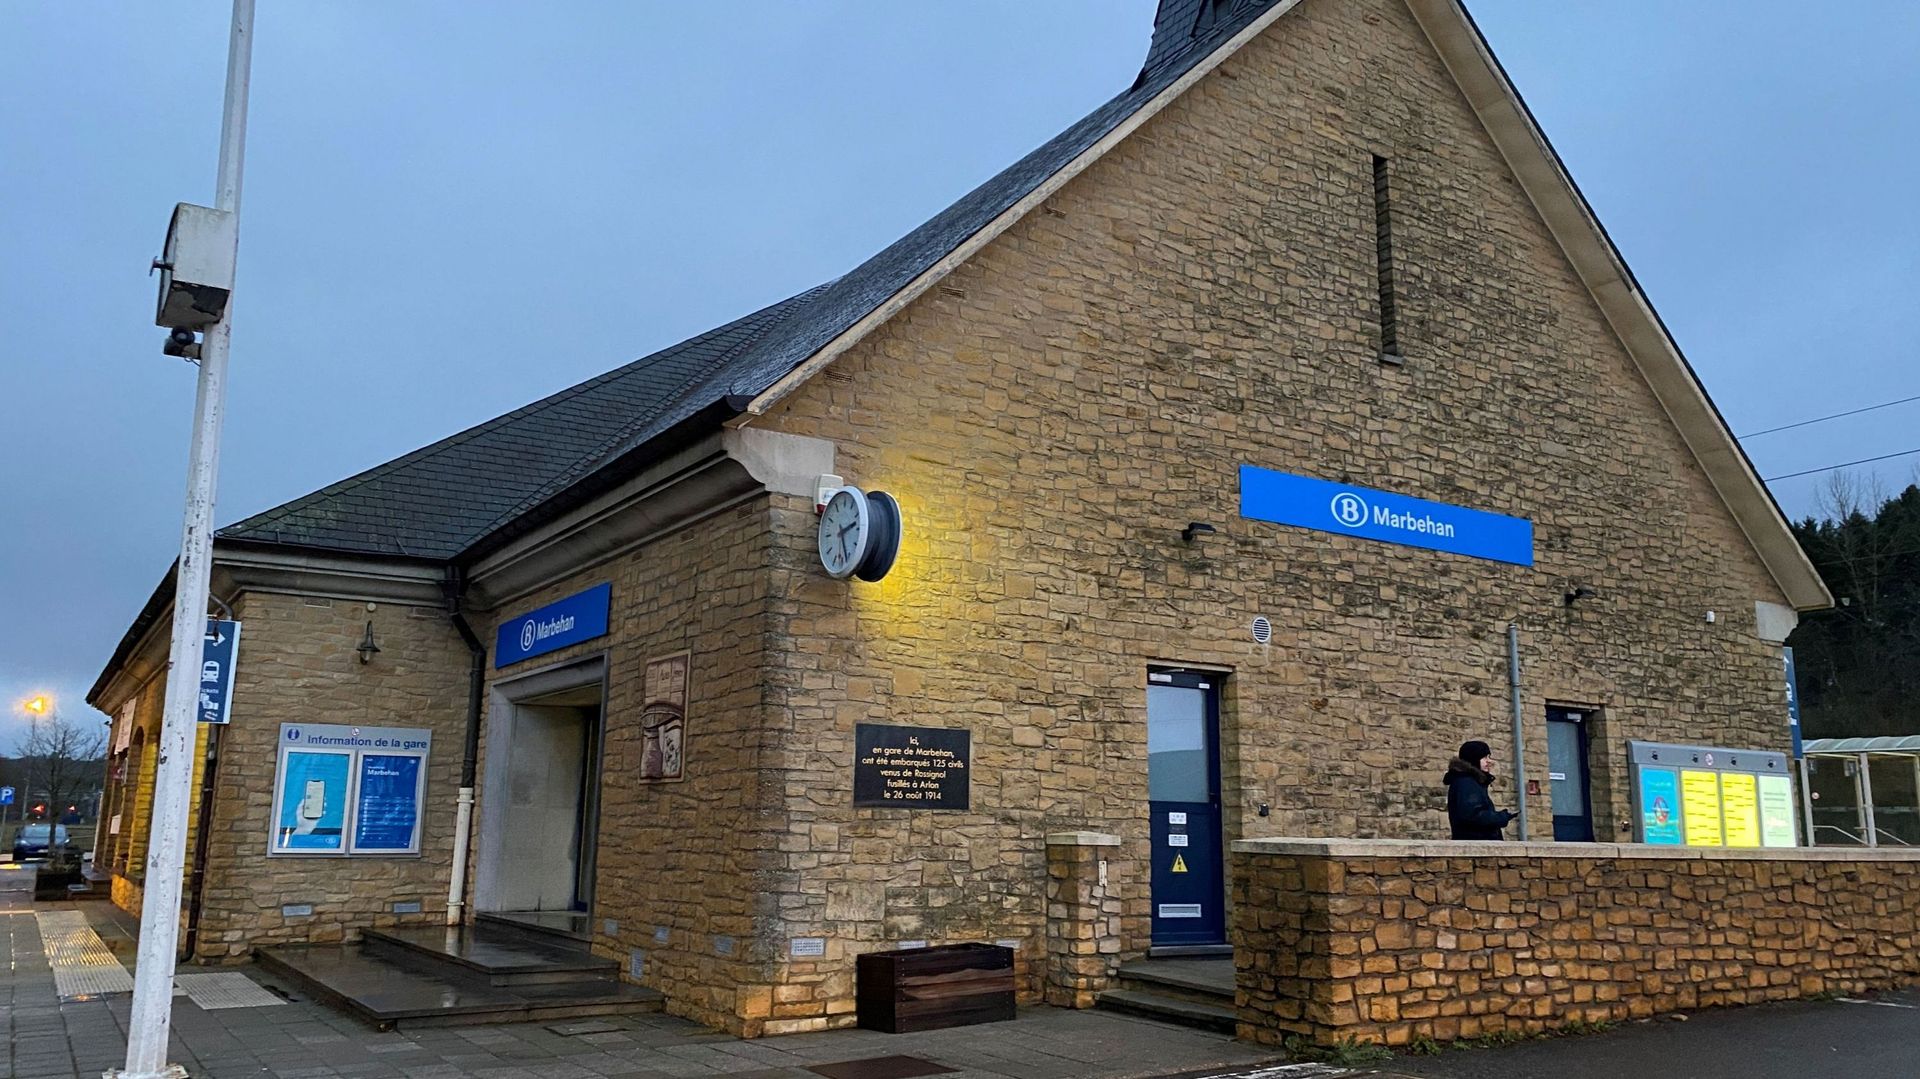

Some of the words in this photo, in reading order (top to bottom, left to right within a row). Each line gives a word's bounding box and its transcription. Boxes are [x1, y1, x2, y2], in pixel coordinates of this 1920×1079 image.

[1373, 505, 1455, 538] Marbehan
[536, 614, 575, 640] Marbehan
[308, 735, 372, 747] Information
[375, 737, 389, 747] de
[391, 738, 401, 747] la
[403, 740, 428, 749] gare
[910, 737, 919, 745] Ici,
[884, 748, 902, 756] gare
[915, 748, 955, 758] Marbehan,
[876, 757, 889, 765] été
[890, 758, 931, 768] embarqués
[933, 759, 947, 768] 125
[948, 760, 964, 768] civils
[880, 769, 901, 777] venus
[902, 769, 913, 777] de
[914, 769, 946, 780] Rossignol
[887, 779, 911, 788] fusillés
[912, 780, 918, 788] à
[919, 781, 940, 789] Arlon
[1, 789, 12, 801] P
[884, 790, 891, 799] le
[893, 791, 904, 799] 26
[905, 791, 923, 799] août
[925, 791, 942, 800] 1914
